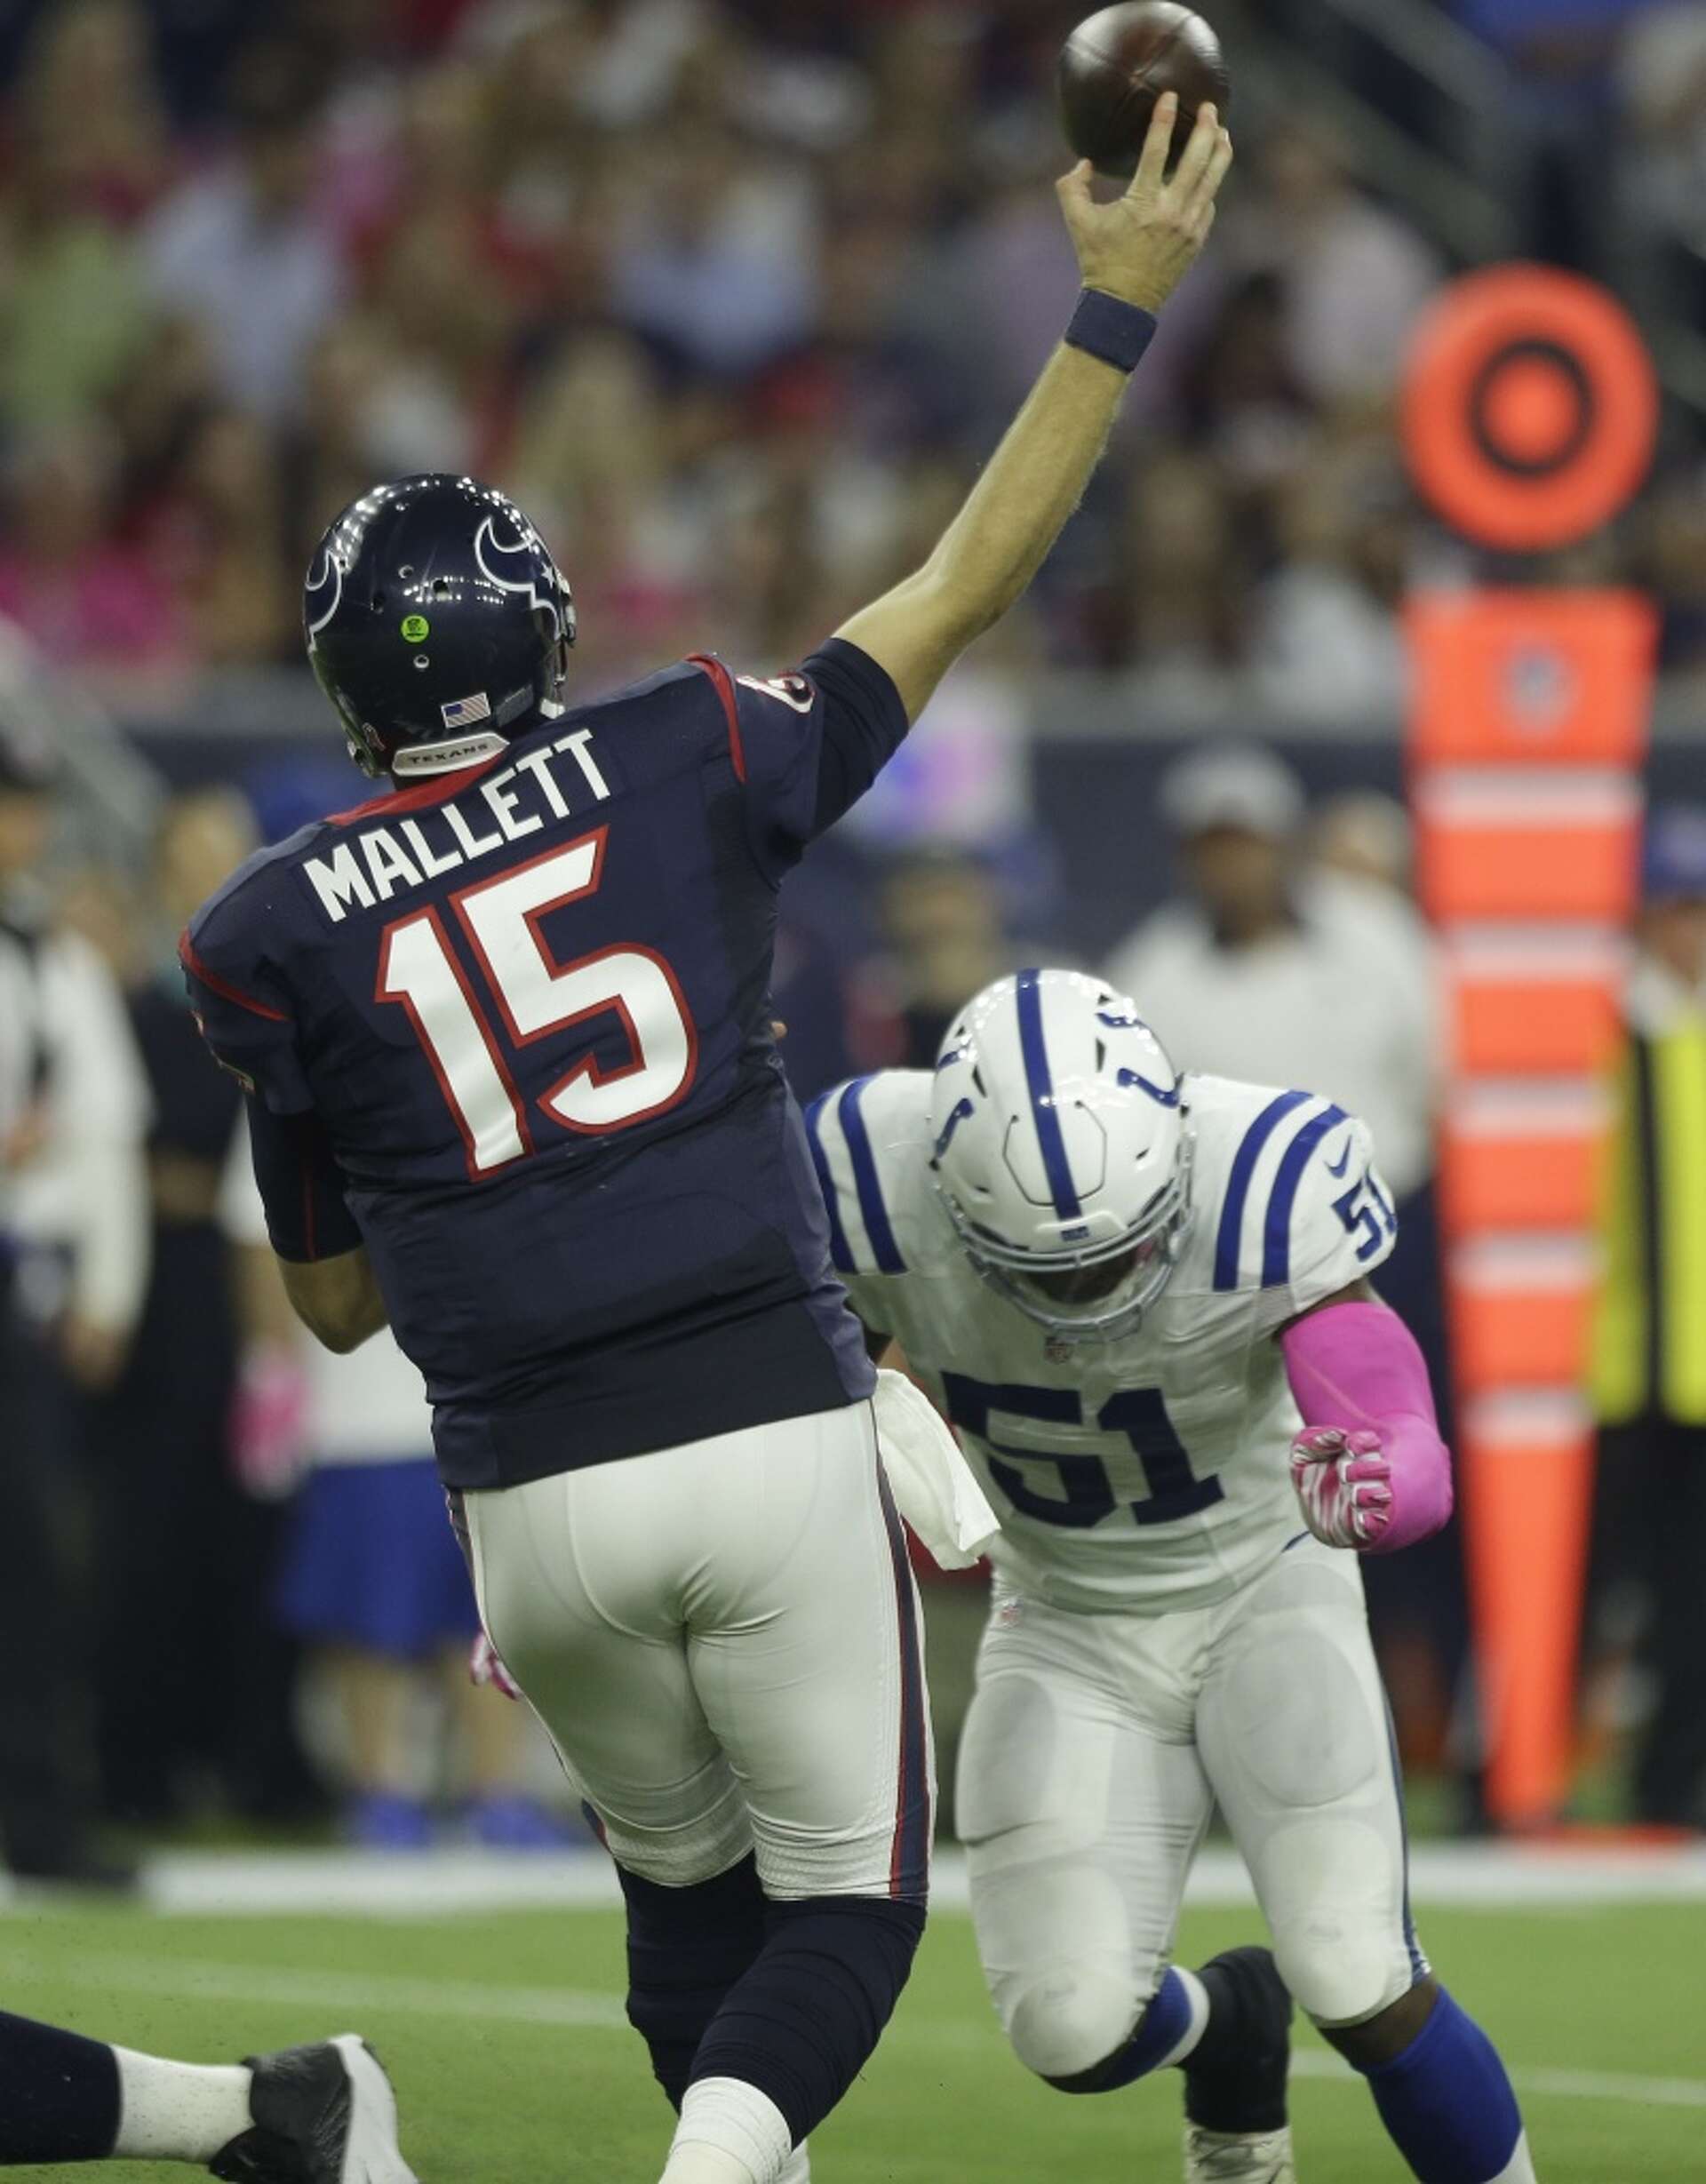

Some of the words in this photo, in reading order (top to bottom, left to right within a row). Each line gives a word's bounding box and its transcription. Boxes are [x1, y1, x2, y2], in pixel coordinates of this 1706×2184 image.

[302, 729, 612, 923] MALLETT
[409, 743, 489, 765] TEXANS
[374, 825, 698, 1183] 15
[1331, 1163, 1399, 1263] 51
[940, 1370, 1225, 1528] 51
